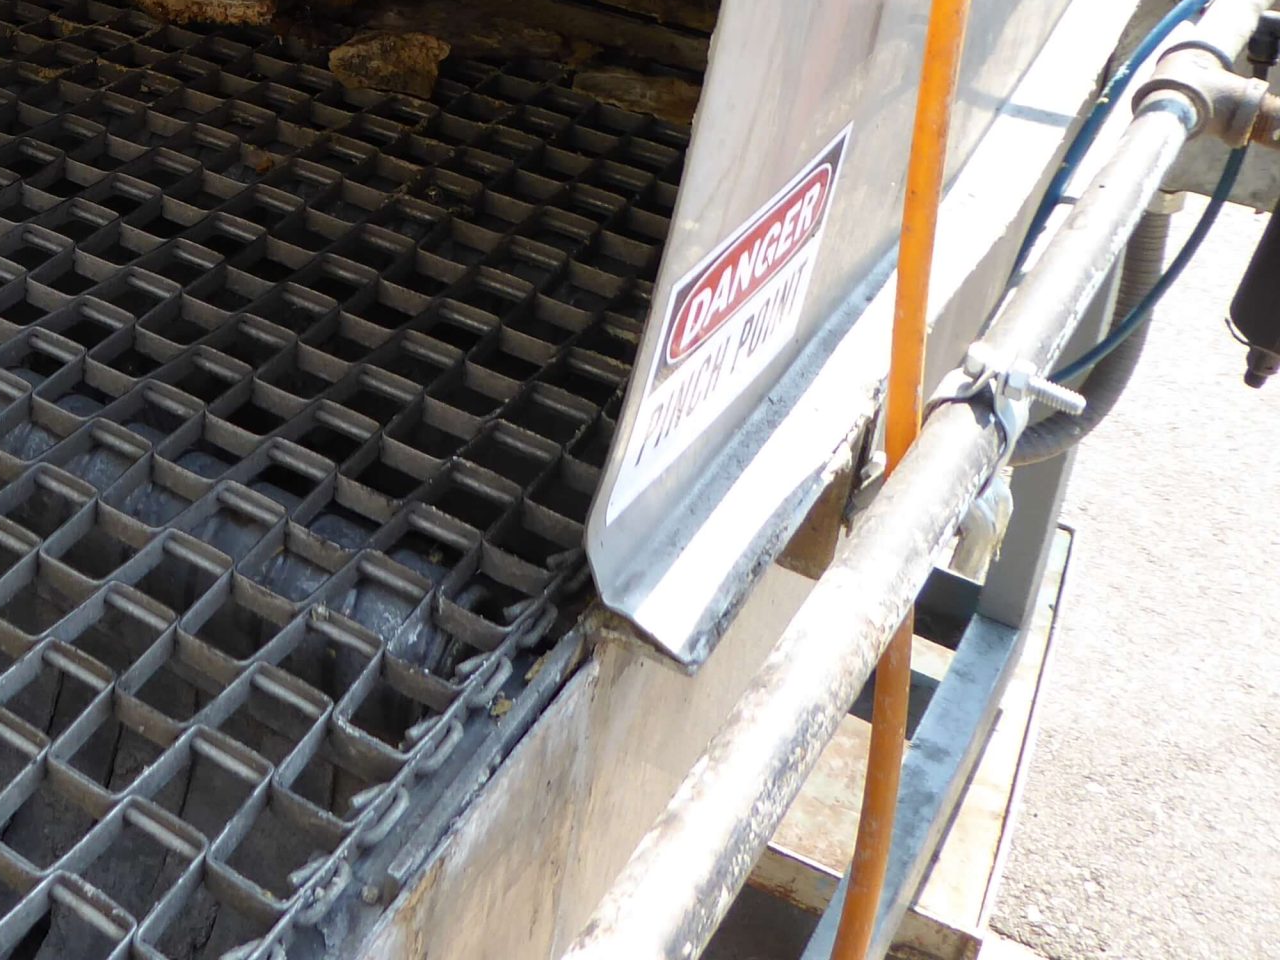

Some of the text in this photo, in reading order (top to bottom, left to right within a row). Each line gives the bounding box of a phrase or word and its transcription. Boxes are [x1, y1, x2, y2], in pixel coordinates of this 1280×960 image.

[680, 181, 821, 348] DANGER
[635, 256, 810, 467] PINCH POINT
